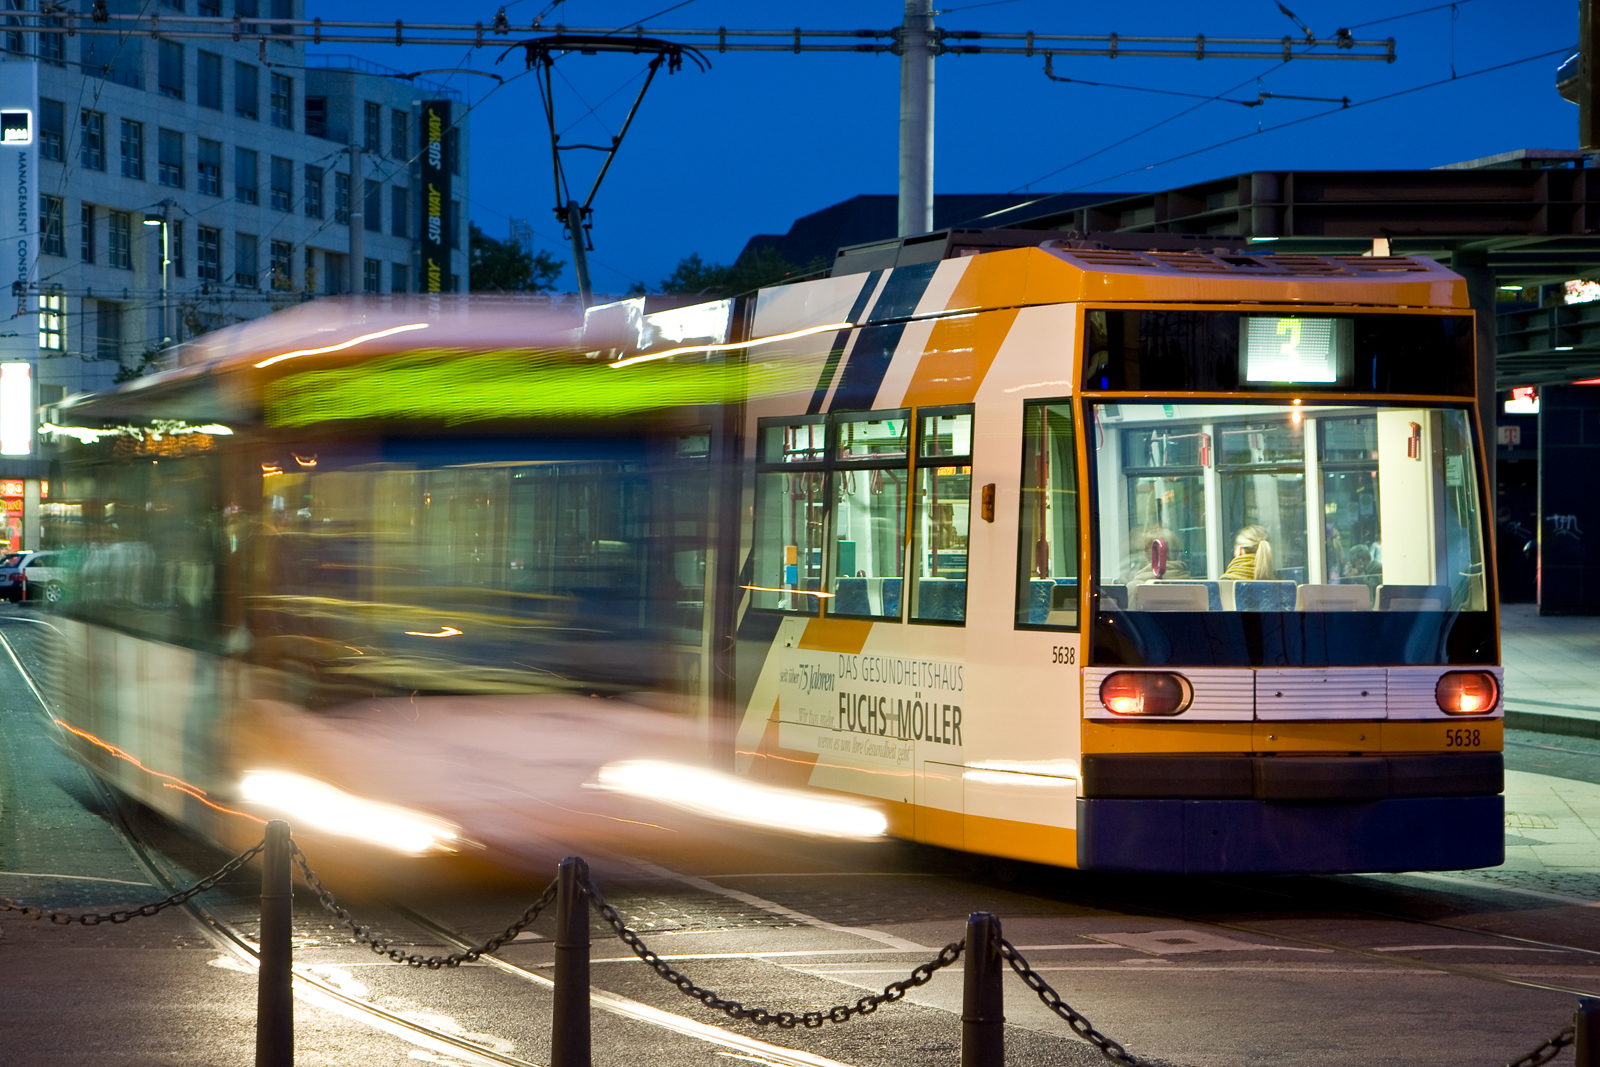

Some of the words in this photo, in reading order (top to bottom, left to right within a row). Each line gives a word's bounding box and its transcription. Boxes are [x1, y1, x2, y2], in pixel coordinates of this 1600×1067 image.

[428, 108, 441, 170] SUBWAY
[18, 151, 28, 233] MANAGEMENT
[428, 183, 441, 245] SUBWAY
[18, 239, 28, 315] CONSUNG
[839, 654, 858, 680] DAS
[861, 656, 964, 692] GESUNDHEITSHAUS
[1052, 645, 1076, 665] 5638
[1446, 728, 1481, 747] 5638
